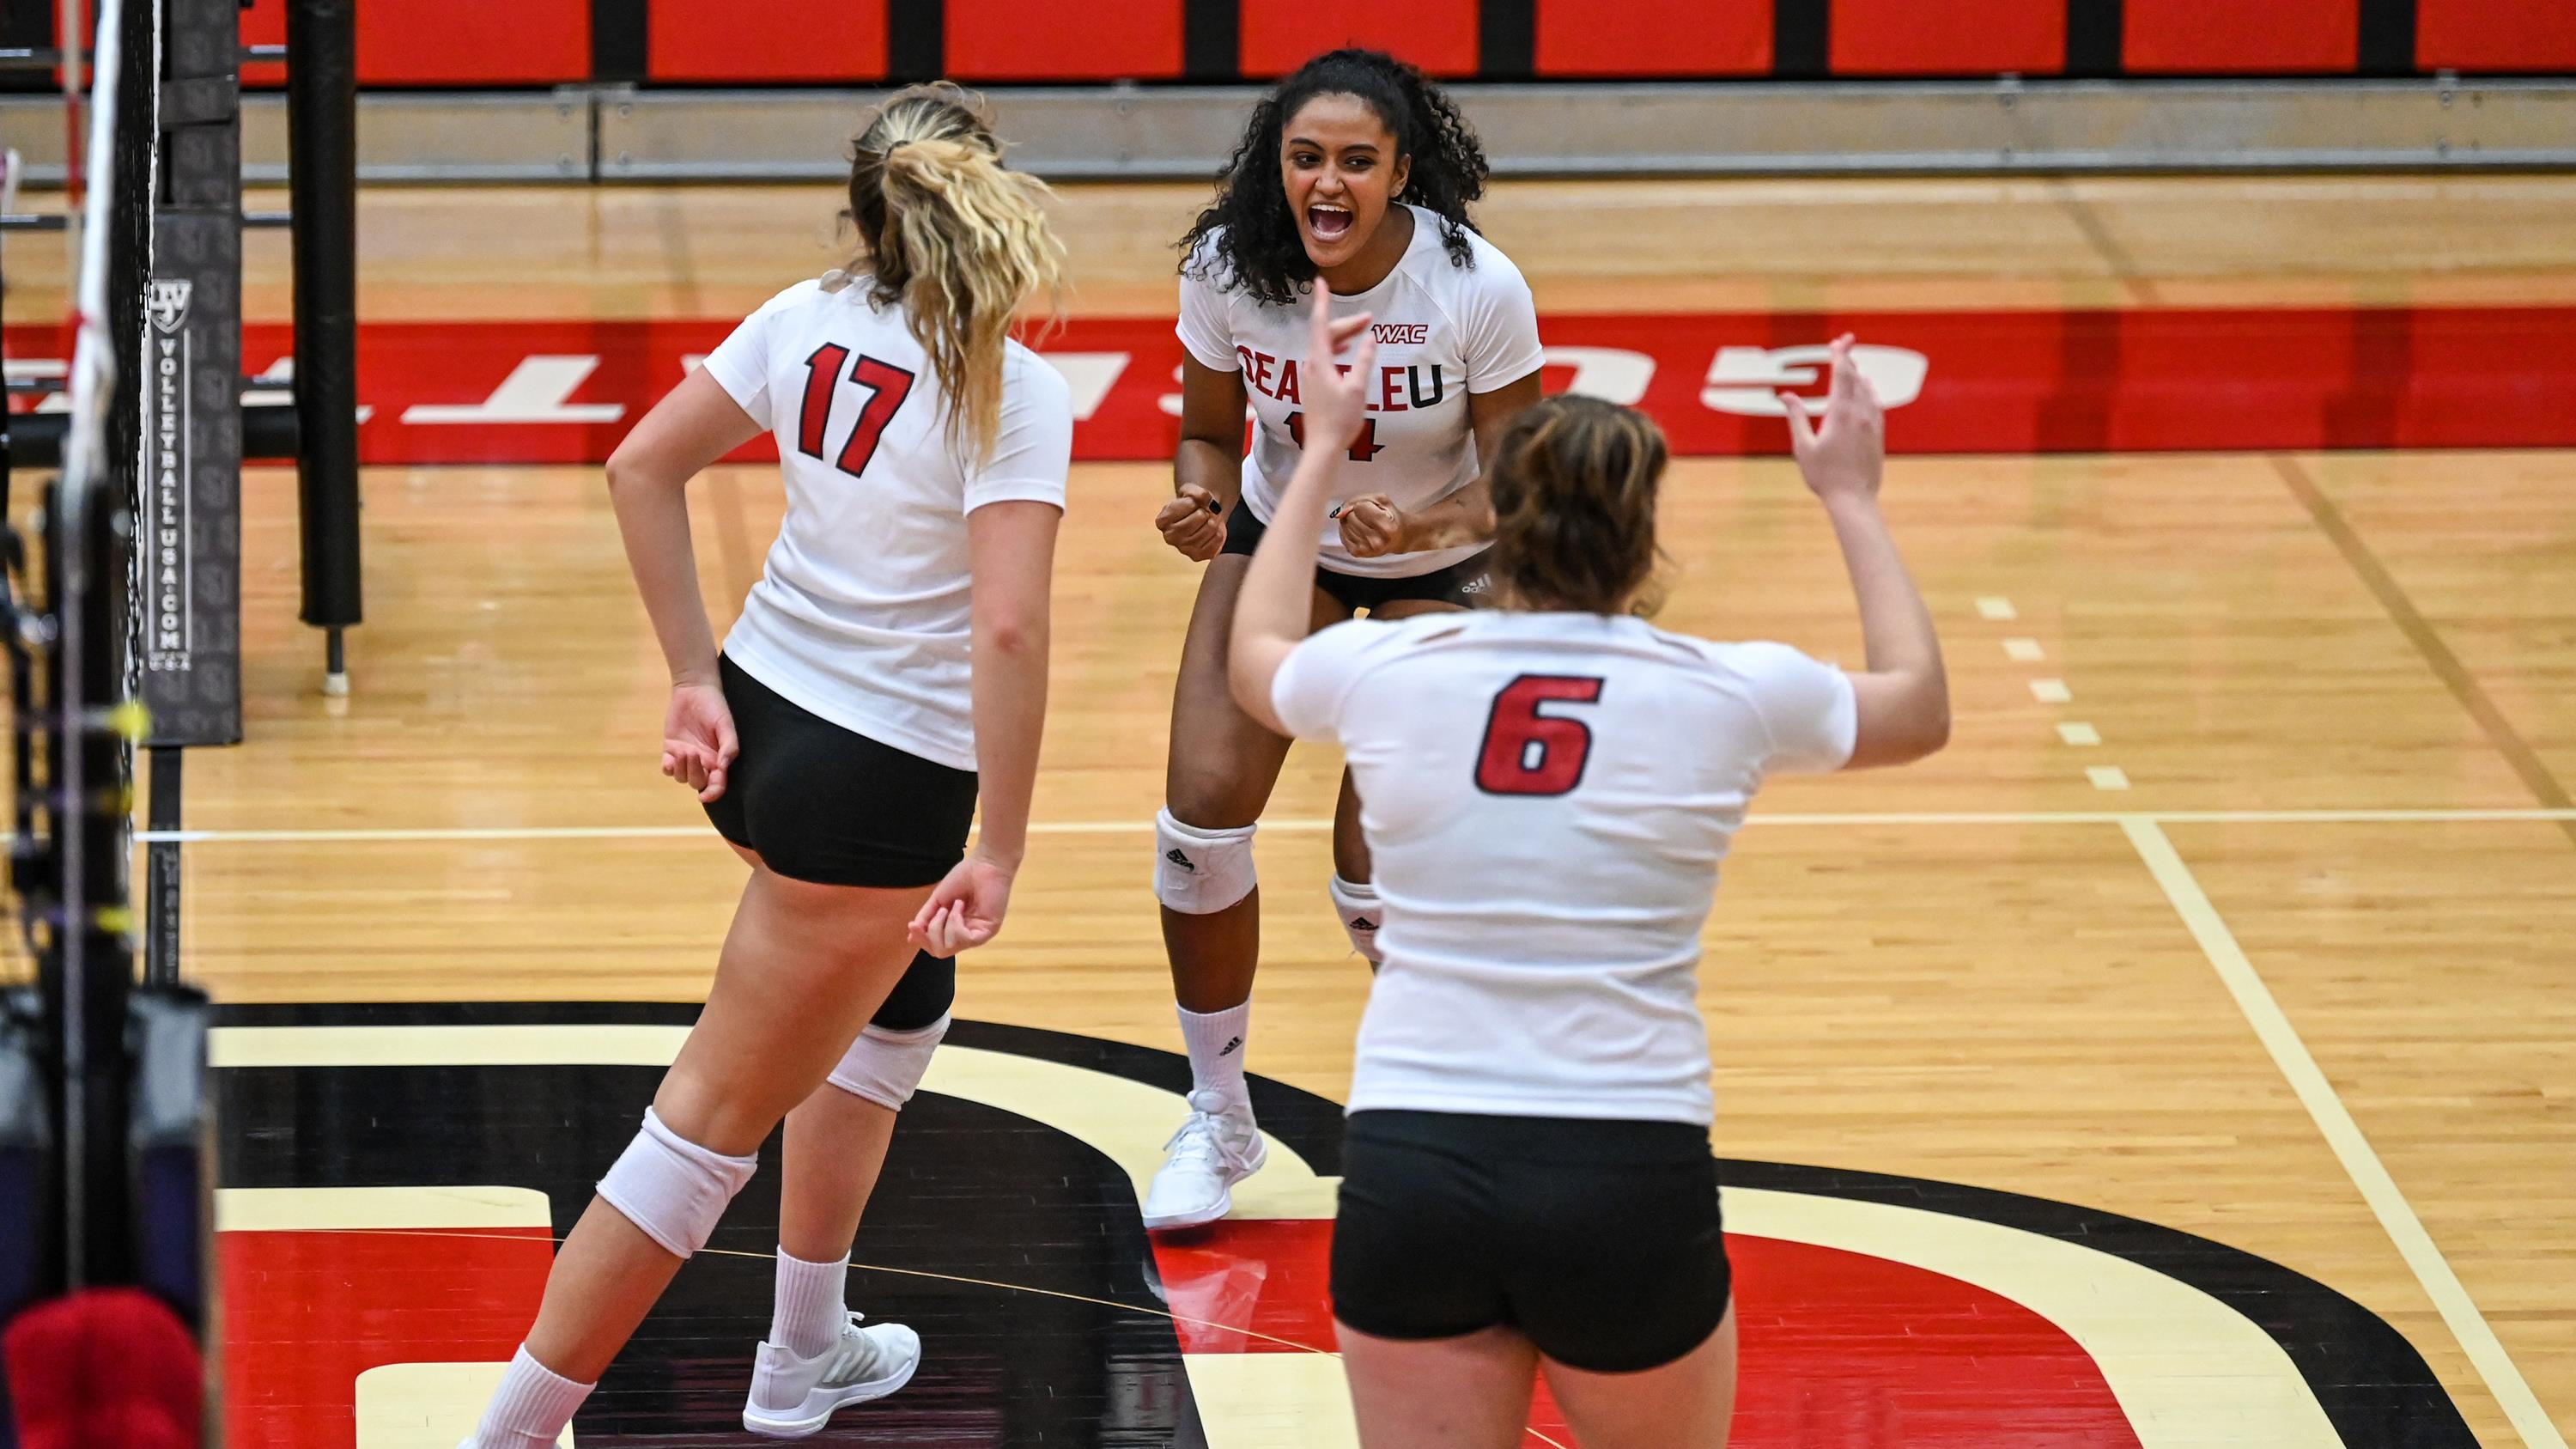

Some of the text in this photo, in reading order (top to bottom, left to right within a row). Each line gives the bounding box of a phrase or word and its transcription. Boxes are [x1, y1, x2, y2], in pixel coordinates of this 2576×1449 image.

[1236, 345, 1443, 411] SEAEU
[1371, 325, 1428, 344] WAC
[798, 342, 915, 478] 17
[1474, 674, 1605, 797] 6
